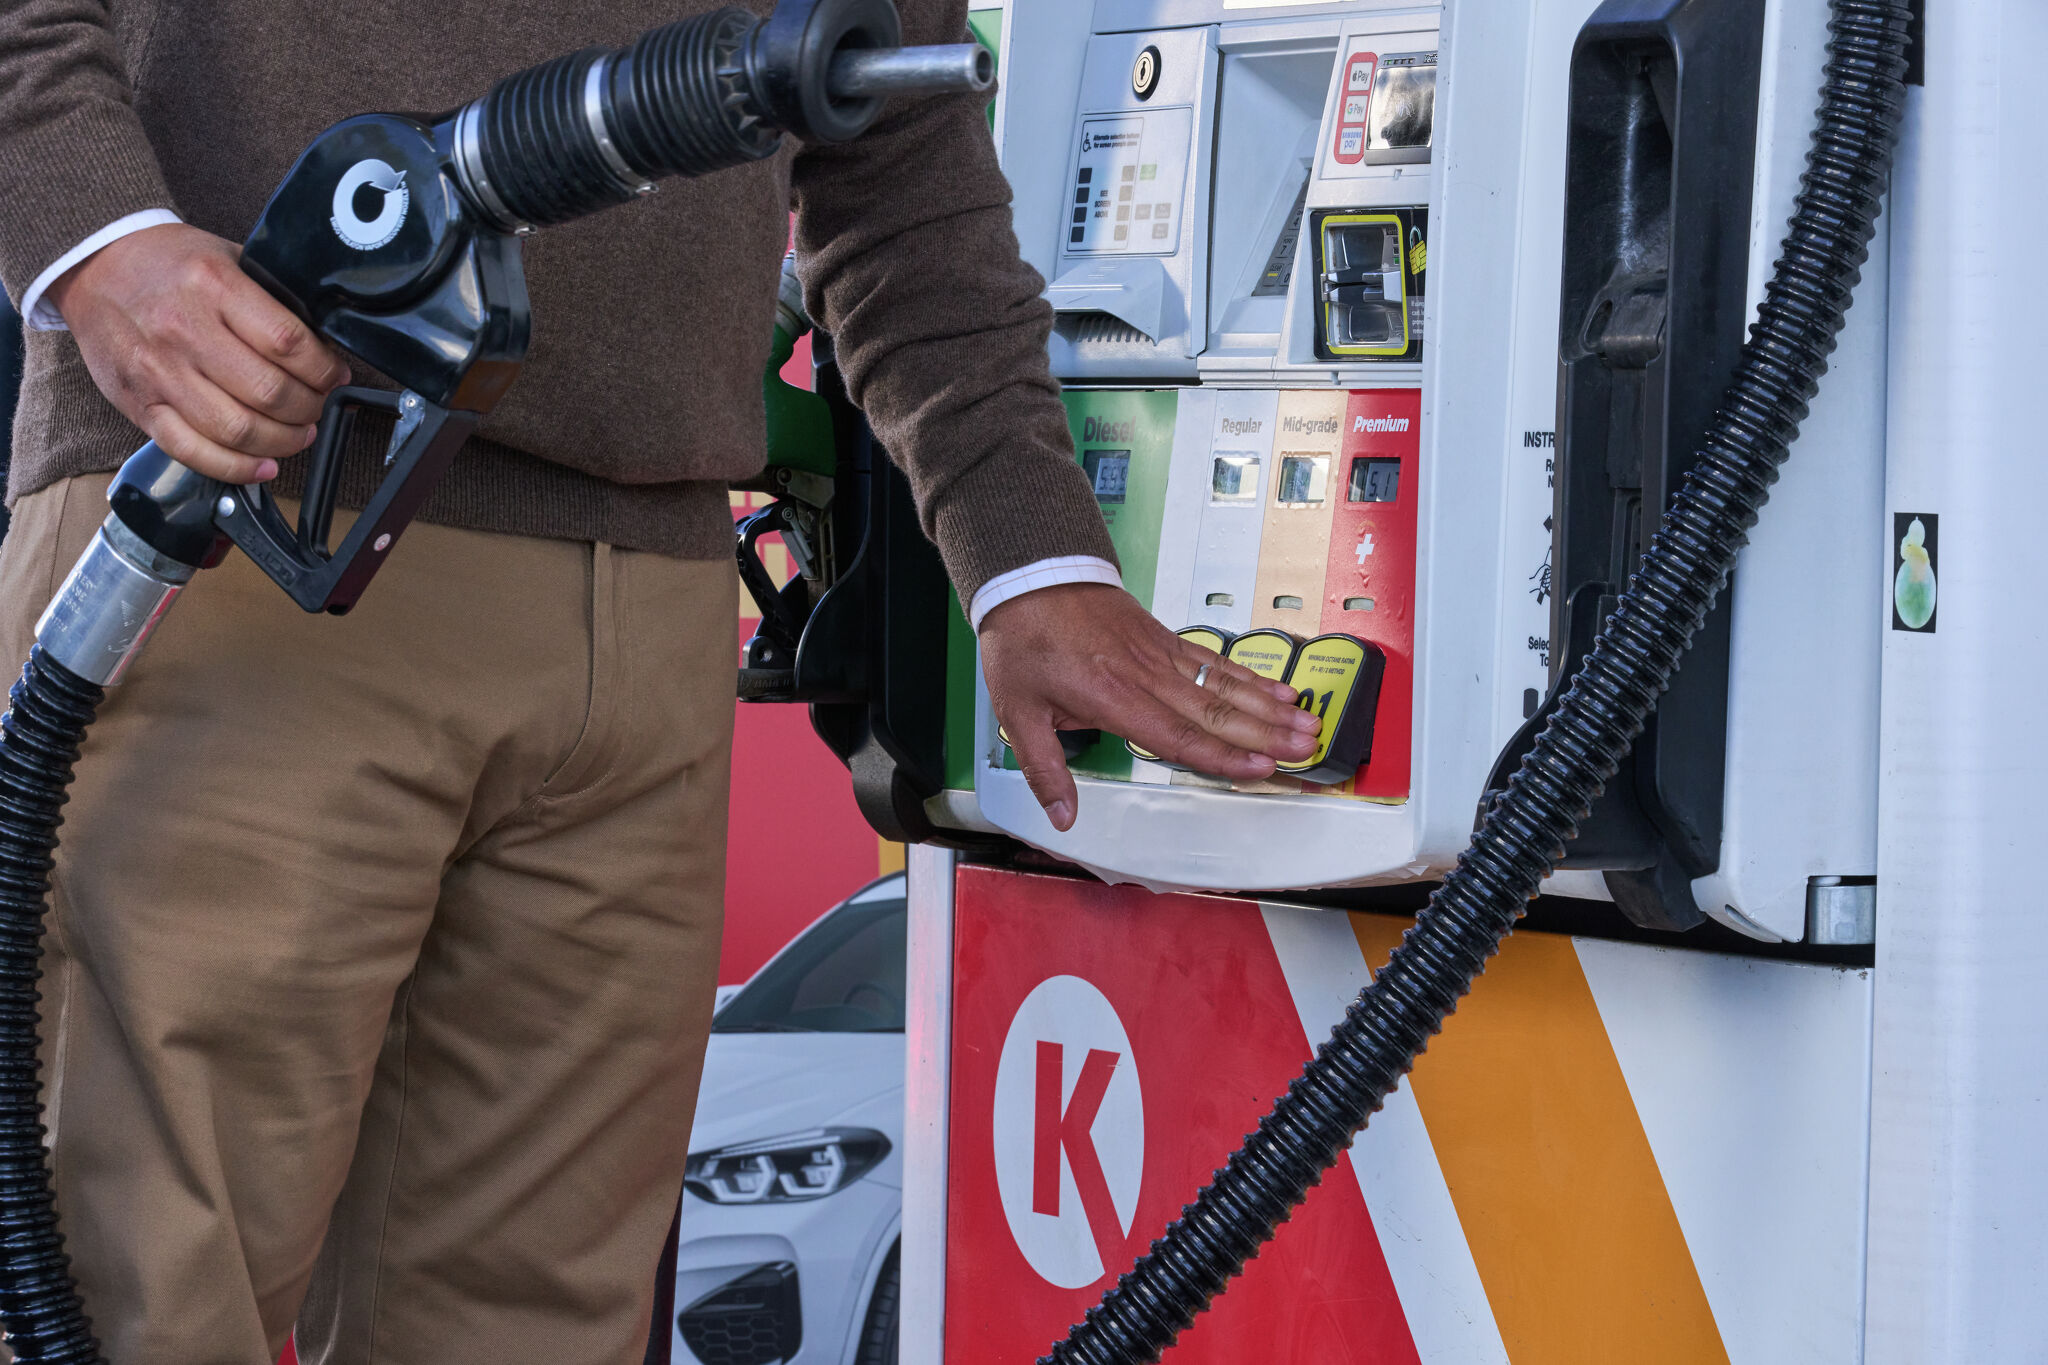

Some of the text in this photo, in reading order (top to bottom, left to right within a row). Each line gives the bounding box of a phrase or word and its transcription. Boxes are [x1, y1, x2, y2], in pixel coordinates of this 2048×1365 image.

[1357, 70, 1370, 84] Pay
[1354, 103, 1364, 117] Pay
[1344, 139, 1356, 150] pay
[1084, 416, 1136, 443] Diesel
[1221, 418, 1263, 436] Regular
[1282, 416, 1338, 435] Mid-grade
[1353, 414, 1410, 433] Premium
[1033, 1040, 1127, 1273] K
